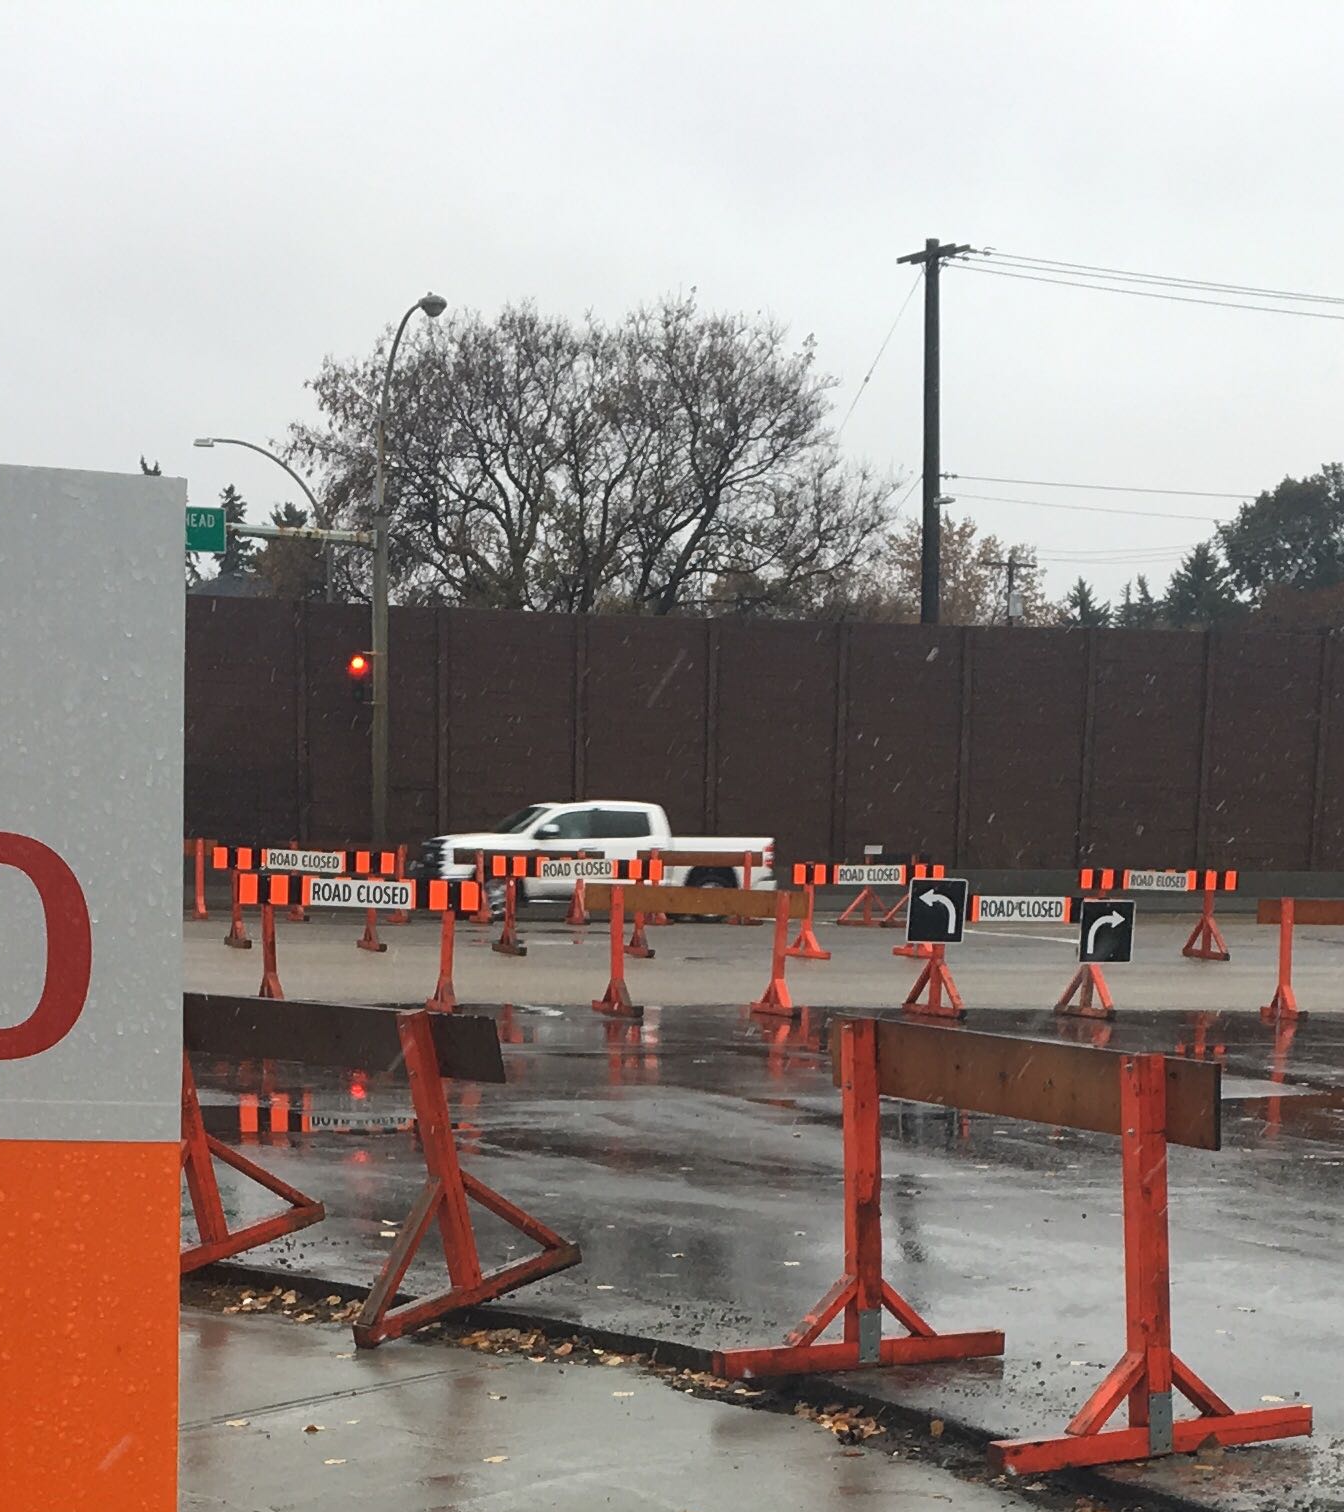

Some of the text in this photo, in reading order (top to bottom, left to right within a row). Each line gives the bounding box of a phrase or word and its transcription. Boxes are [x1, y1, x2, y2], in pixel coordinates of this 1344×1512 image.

[269, 852, 340, 869] ROAD CLOSED
[542, 860, 612, 878] ROAD CLOSED
[839, 867, 901, 882] ROAD CLOSED
[1130, 874, 1186, 888] ROAD CLOSED
[312, 882, 409, 905] ROAD CLOSED
[980, 900, 1063, 918] ROAD CLOSED
